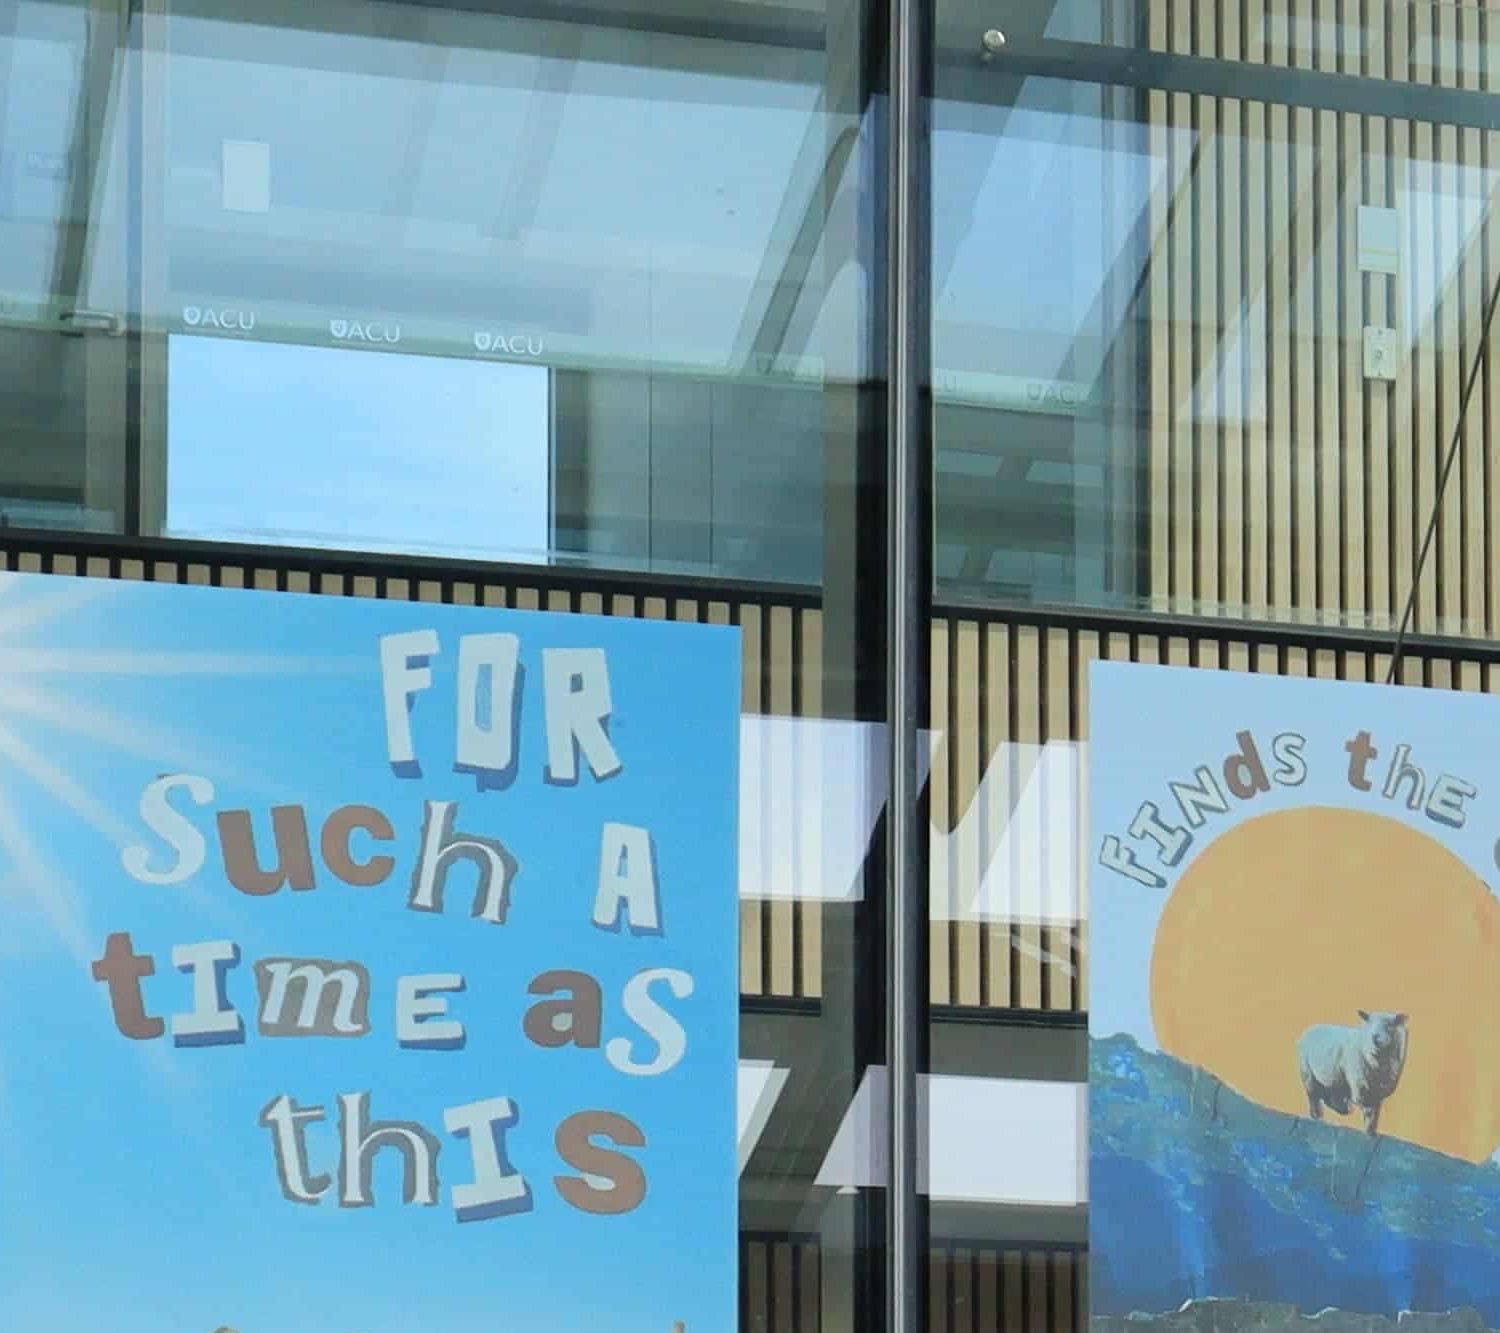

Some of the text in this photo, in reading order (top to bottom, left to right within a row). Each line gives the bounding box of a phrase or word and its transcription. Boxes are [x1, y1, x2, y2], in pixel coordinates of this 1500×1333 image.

[202, 308, 255, 330] ACU
[347, 321, 400, 343] ACU
[490, 333, 543, 356] ACU
[380, 629, 621, 791] FOR
[592, 822, 663, 938] A
